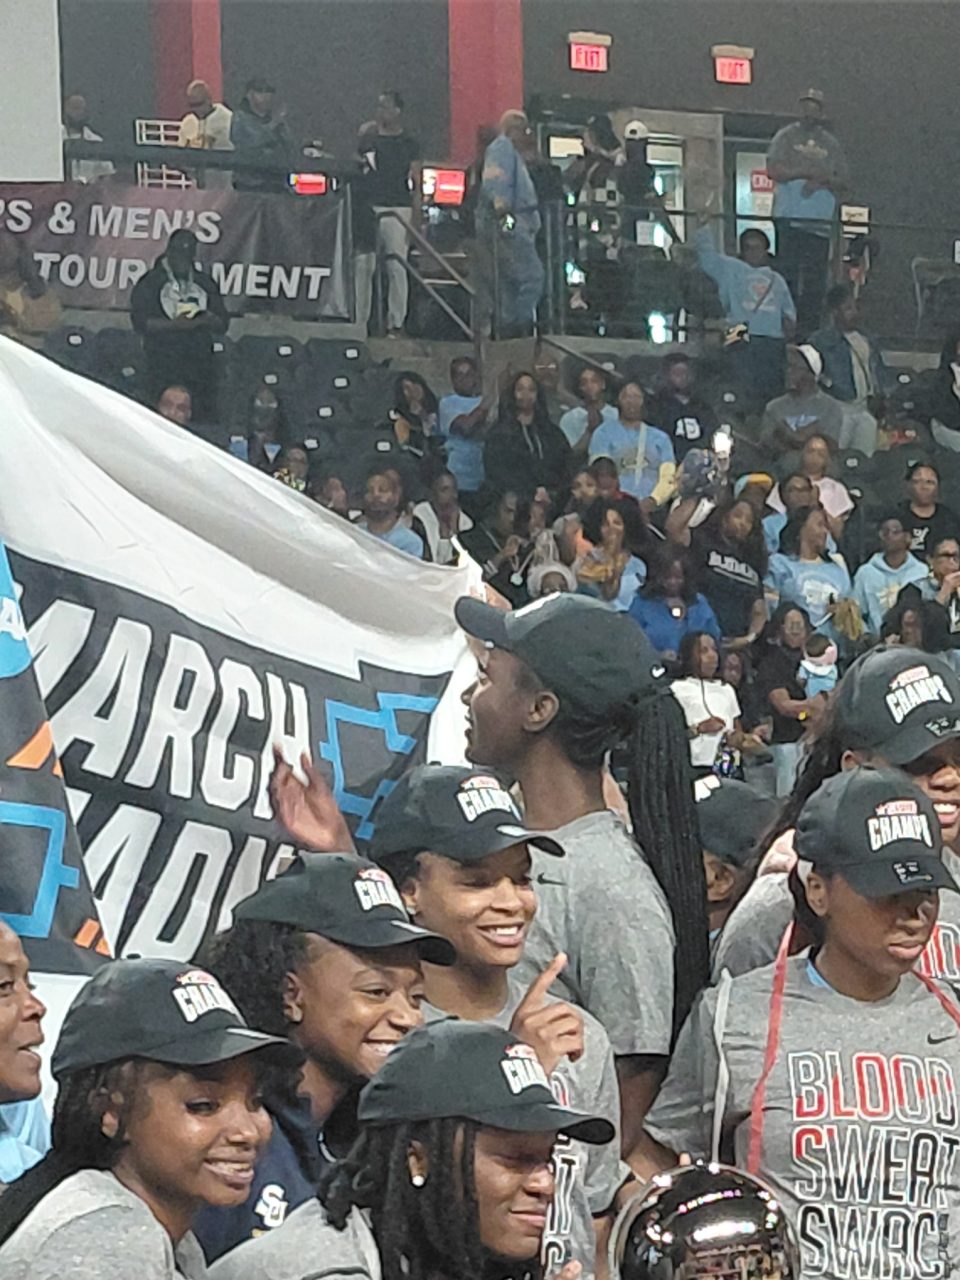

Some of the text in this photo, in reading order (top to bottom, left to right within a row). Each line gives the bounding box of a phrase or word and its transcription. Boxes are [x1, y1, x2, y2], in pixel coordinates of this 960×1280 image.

[48, 201, 76, 234] &
[88, 204, 222, 244] MEN'S
[33, 251, 332, 300] TOURMENT
[788, 1051, 960, 1127] BLOOD
[255, 1184, 288, 1227] SU
[796, 1204, 946, 1280] SWAC
